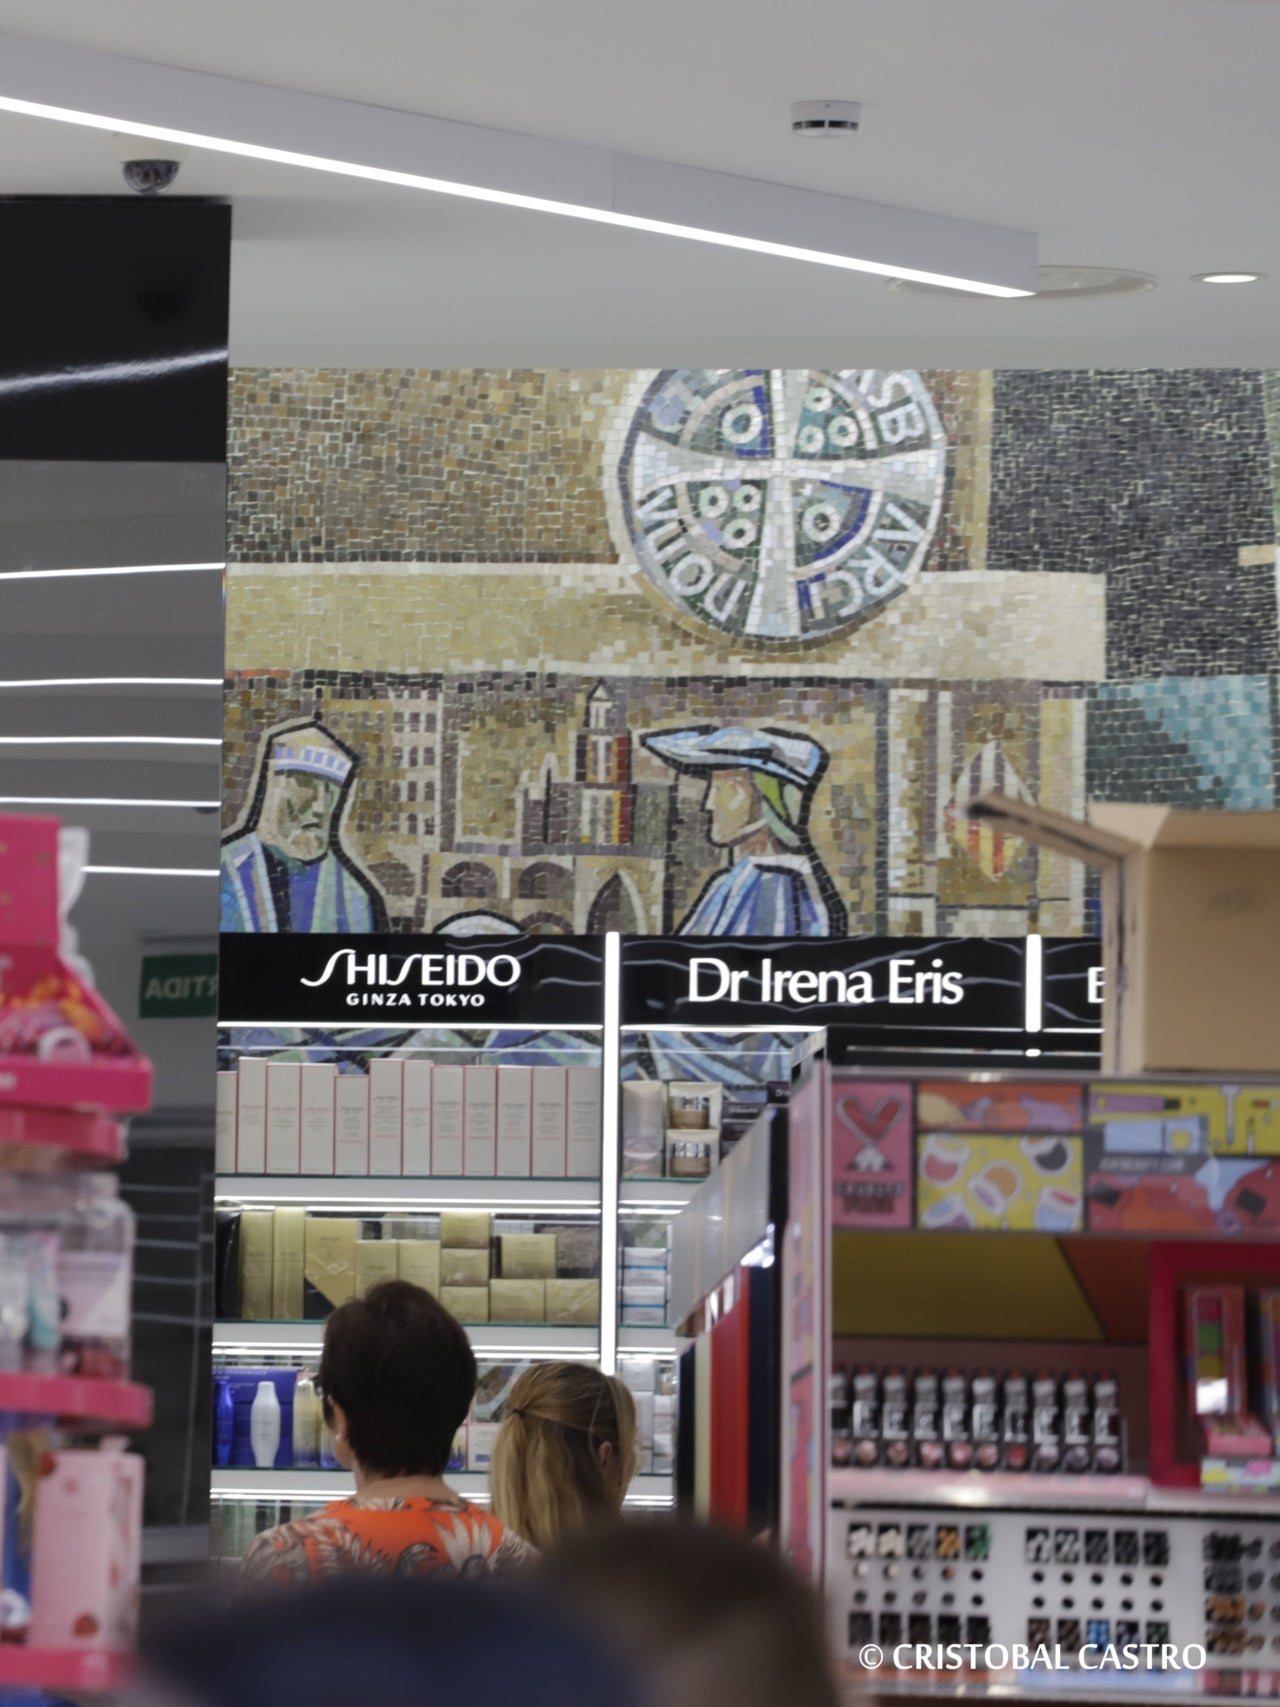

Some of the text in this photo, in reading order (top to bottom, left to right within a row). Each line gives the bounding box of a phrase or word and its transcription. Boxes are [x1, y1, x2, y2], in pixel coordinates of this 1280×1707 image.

[301, 949, 521, 987] SHISEIDO
[688, 957, 964, 1005] Dr Irena Eris
[346, 993, 485, 1007] GINZA TOKYO
